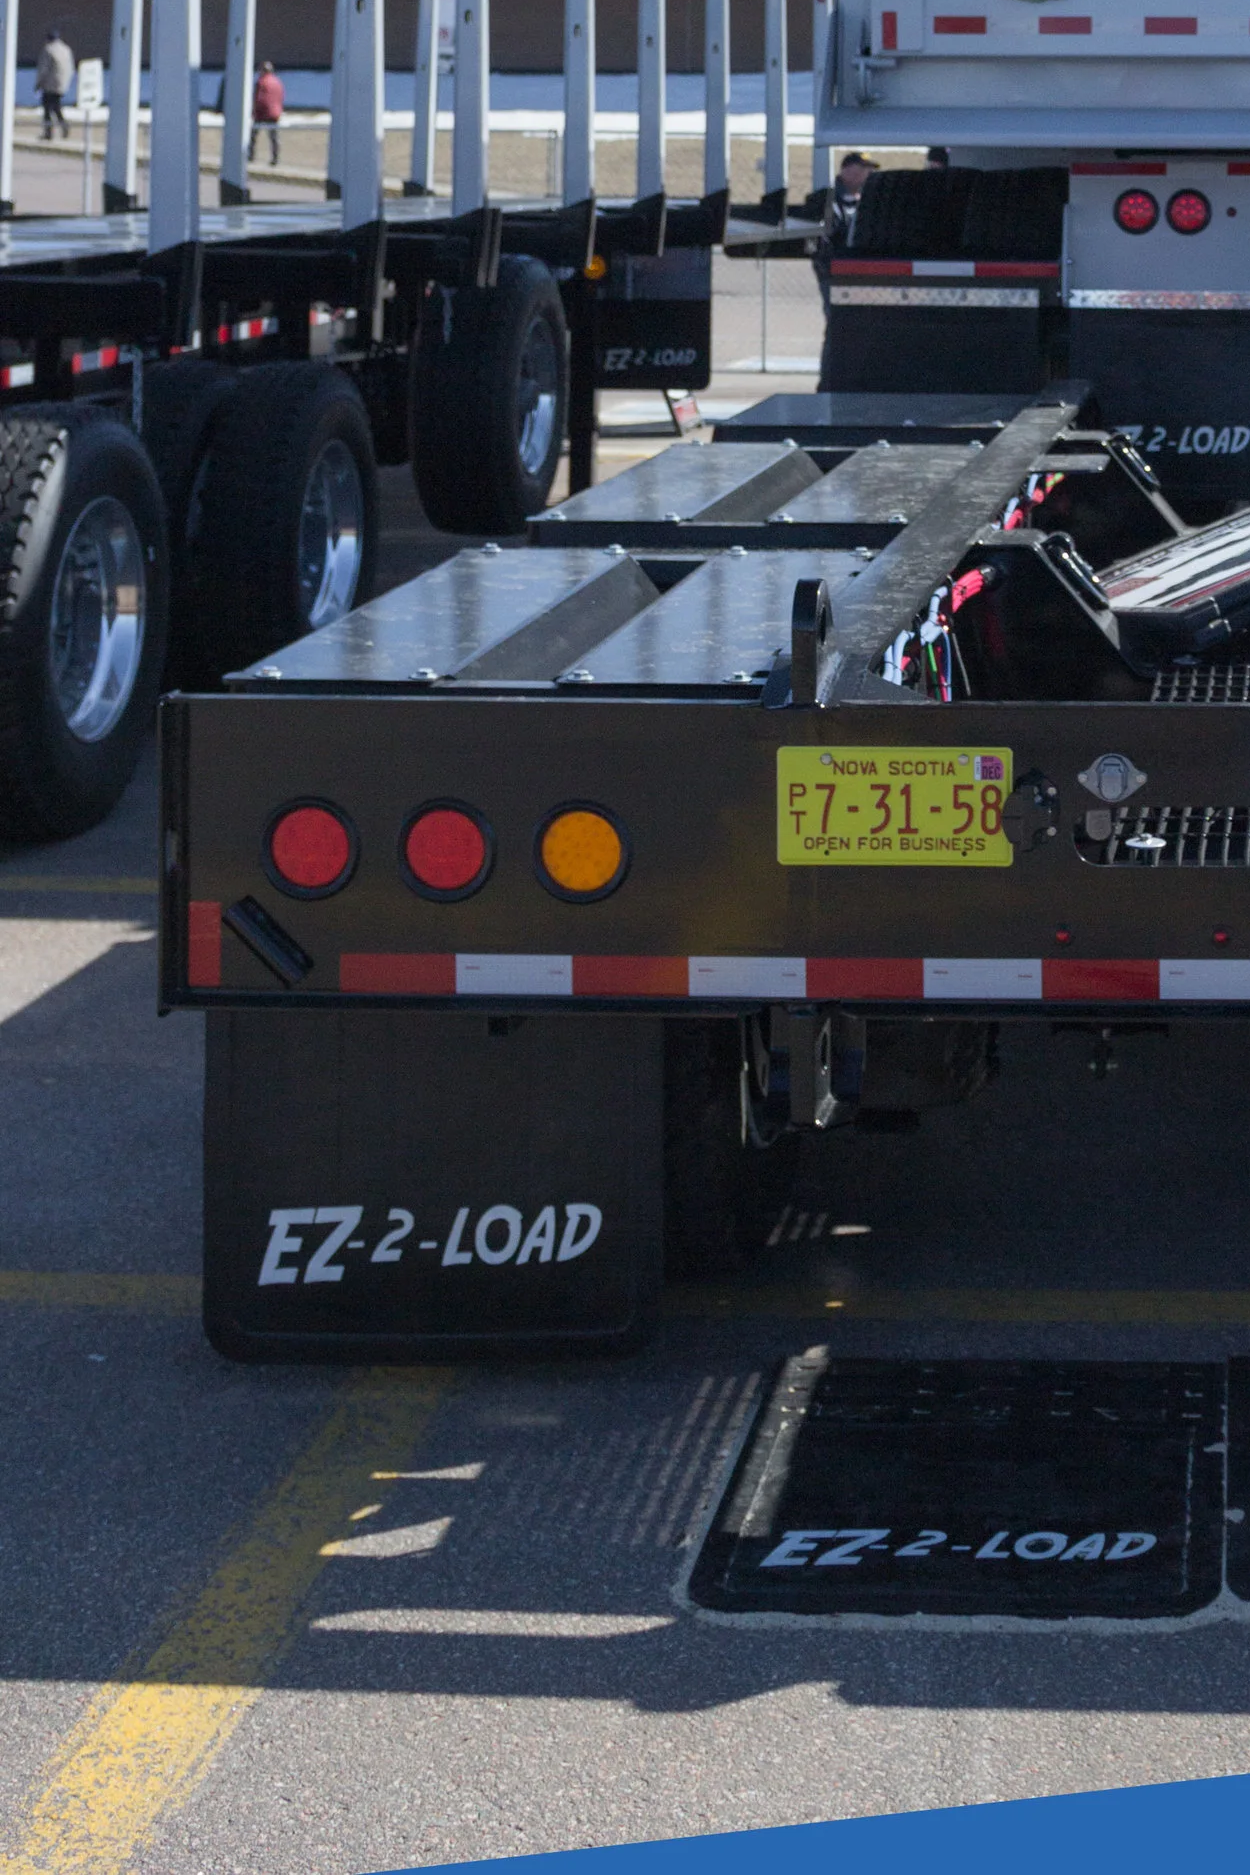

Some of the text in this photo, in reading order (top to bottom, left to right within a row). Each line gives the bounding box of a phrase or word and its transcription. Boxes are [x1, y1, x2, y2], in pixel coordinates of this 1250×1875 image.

[604, 347, 698, 372] EZ-2-LOAD
[1114, 425, 1250, 454] Z-2-LOAD
[832, 760, 878, 776] NOVA
[888, 760, 956, 776] SCOTIA
[814, 783, 1003, 836] 7-31-58
[804, 836, 986, 852] OPEN FOR BUSINESS
[258, 1203, 603, 1286] EZ-2-LOAD
[759, 1528, 1158, 1567] EZ-2-LOAD
